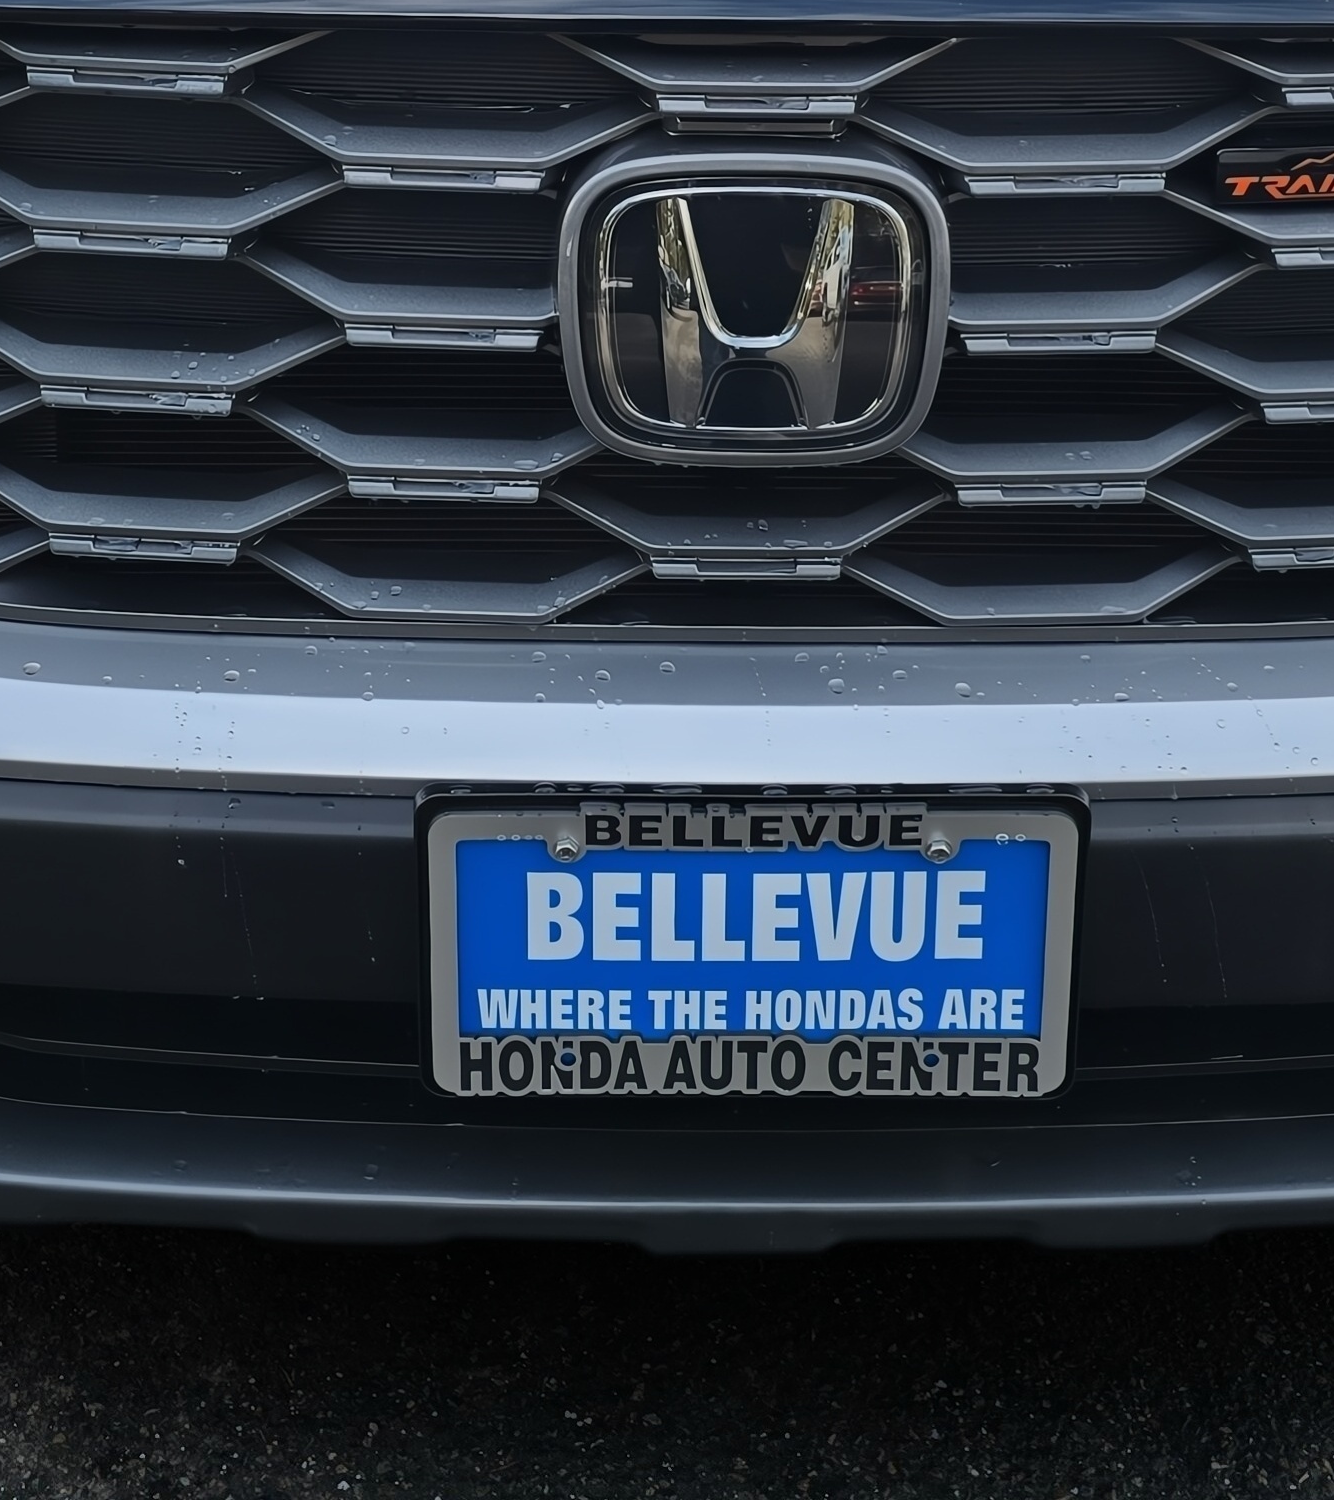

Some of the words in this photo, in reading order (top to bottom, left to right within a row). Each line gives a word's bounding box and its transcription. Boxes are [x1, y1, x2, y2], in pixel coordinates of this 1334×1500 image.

[584, 813, 924, 848] BELLEVUE
[526, 869, 986, 963] BELLEVUE
[477, 989, 632, 1030] WHERE
[648, 989, 728, 1030] THE
[744, 987, 925, 1031] HONDAS
[937, 988, 1025, 1030] ARE
[459, 1039, 647, 1092] HONDA
[663, 1039, 807, 1092] AUTO
[827, 1039, 1041, 1092] CENTER
